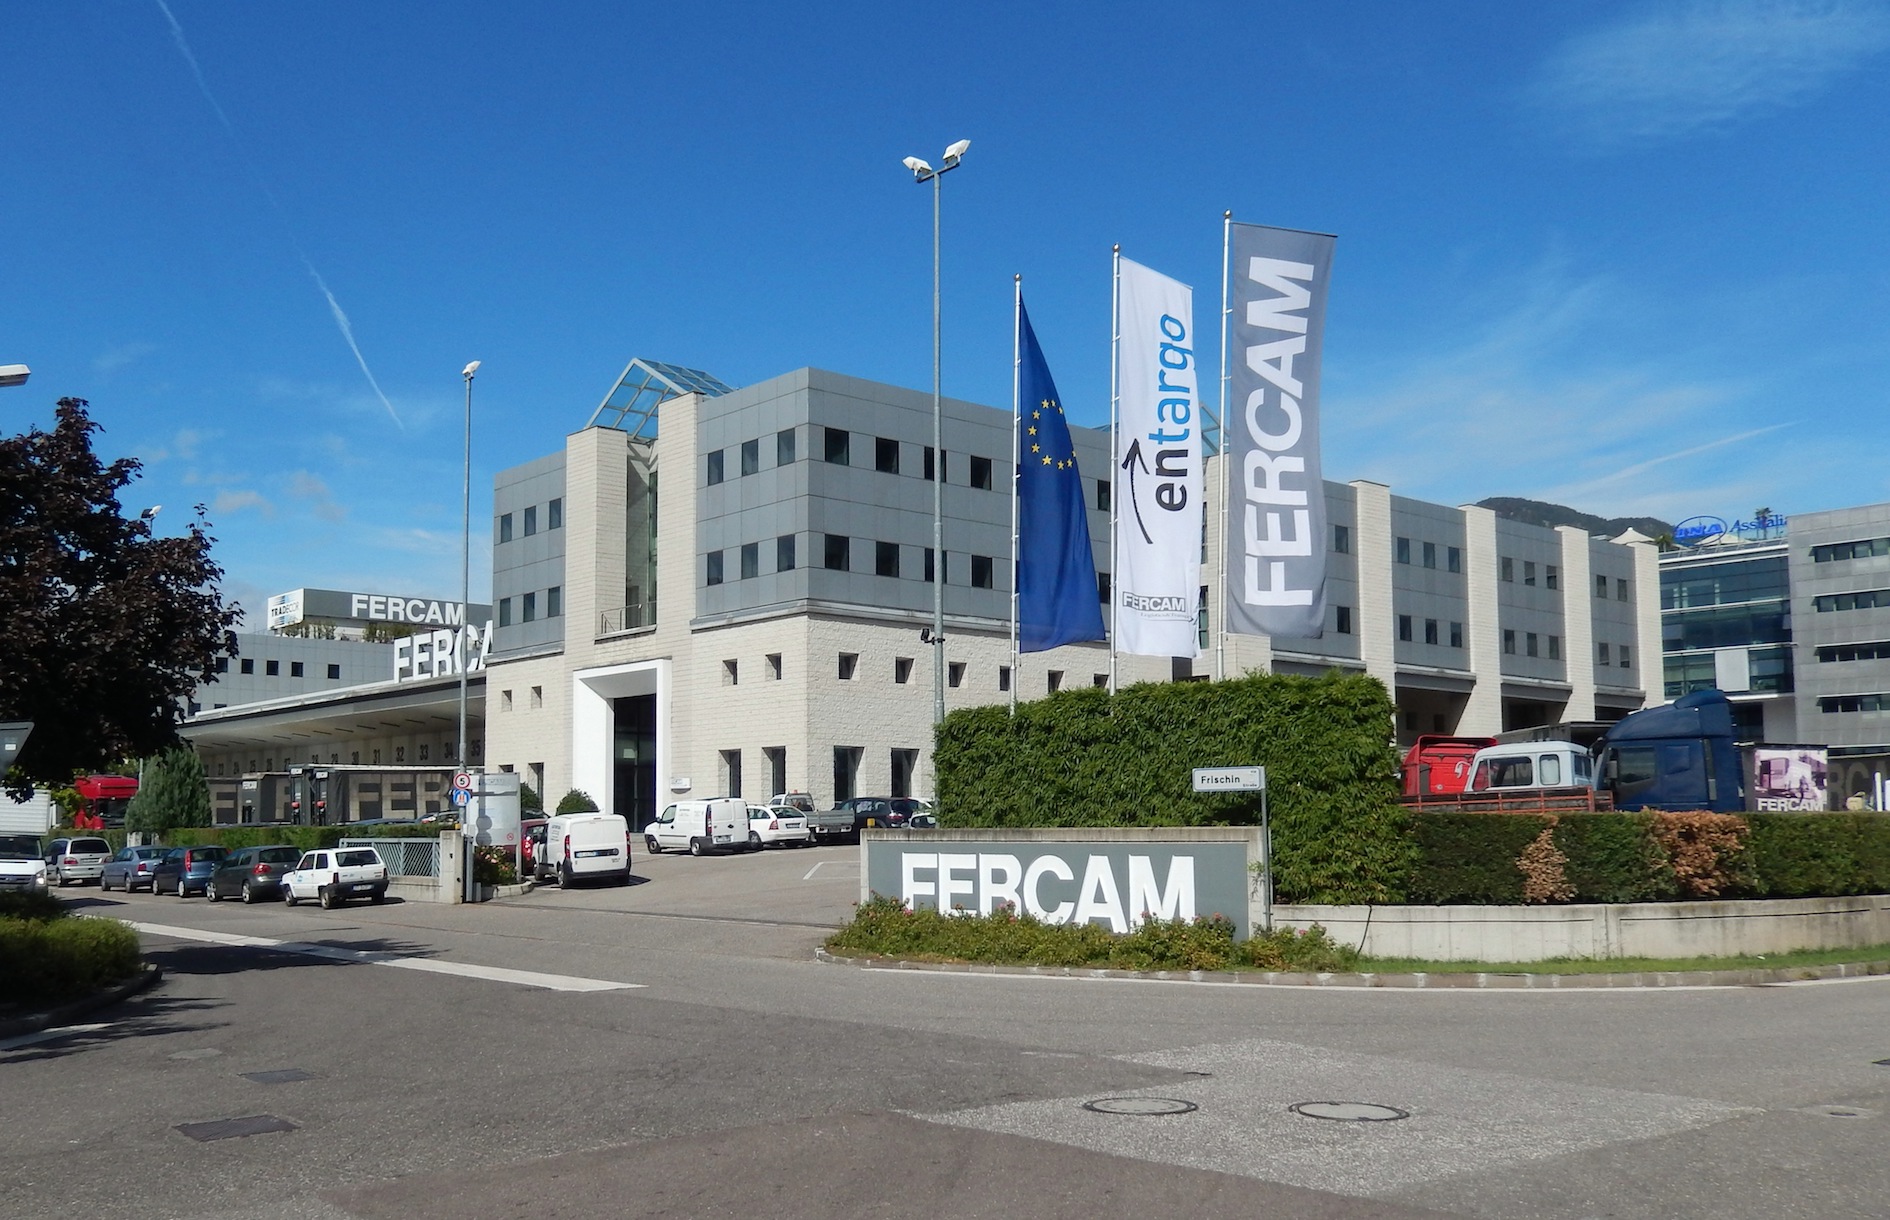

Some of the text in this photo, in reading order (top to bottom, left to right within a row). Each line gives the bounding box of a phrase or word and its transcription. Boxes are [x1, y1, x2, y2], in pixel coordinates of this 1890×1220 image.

[1148, 313, 1194, 512] entargo
[1244, 256, 1315, 606] FERCAM
[351, 594, 464, 626] FERCAM
[1123, 592, 1186, 612] FERCAM
[373, 749, 381, 764] 31
[396, 746, 405, 762] 32
[420, 744, 429, 760] 33
[1201, 775, 1240, 784] Frischin
[1758, 798, 1825, 812] FERCAM
[901, 852, 1195, 934] FERCAM
